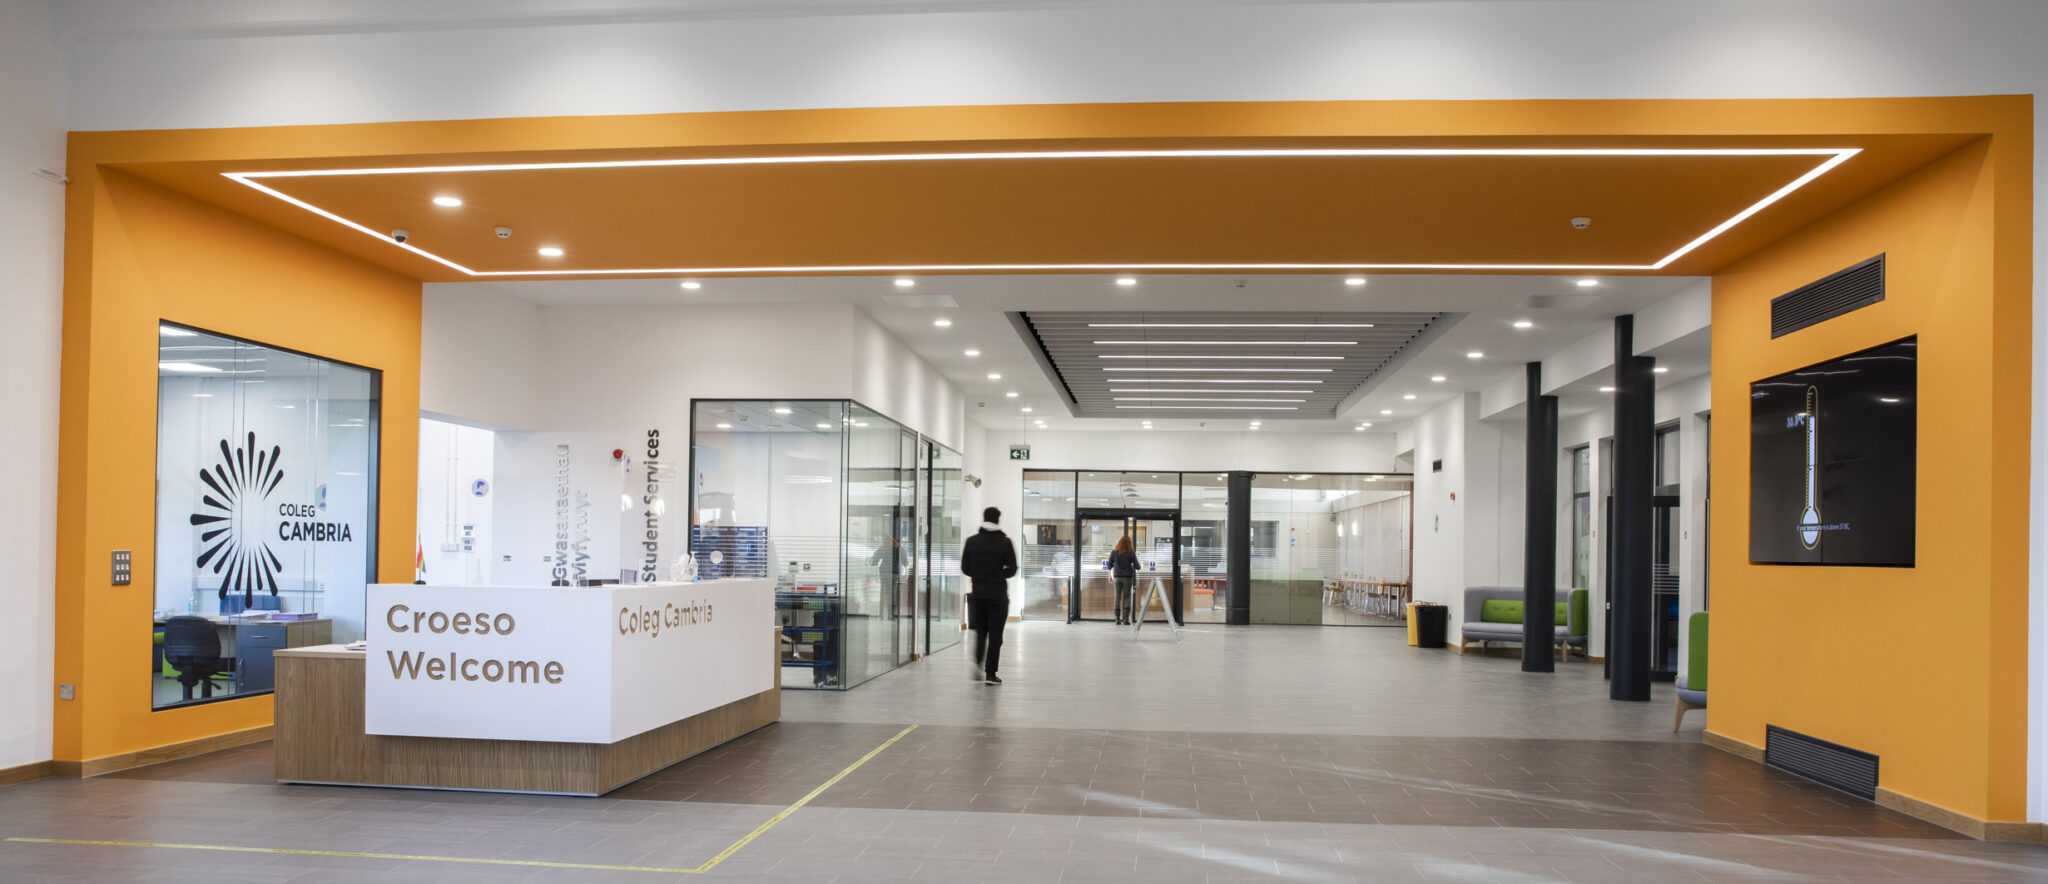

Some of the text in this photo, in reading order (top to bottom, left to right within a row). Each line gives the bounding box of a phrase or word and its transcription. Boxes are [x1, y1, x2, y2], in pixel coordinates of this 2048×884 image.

[279, 503, 315, 517] COLEG
[552, 444, 570, 580] Gwasanaethau
[642, 429, 660, 583] Student Services
[279, 521, 352, 542] CAMBRIA
[387, 604, 515, 635] Croeso
[619, 599, 713, 638] Coleg Cambria
[387, 650, 564, 684] Welcome
